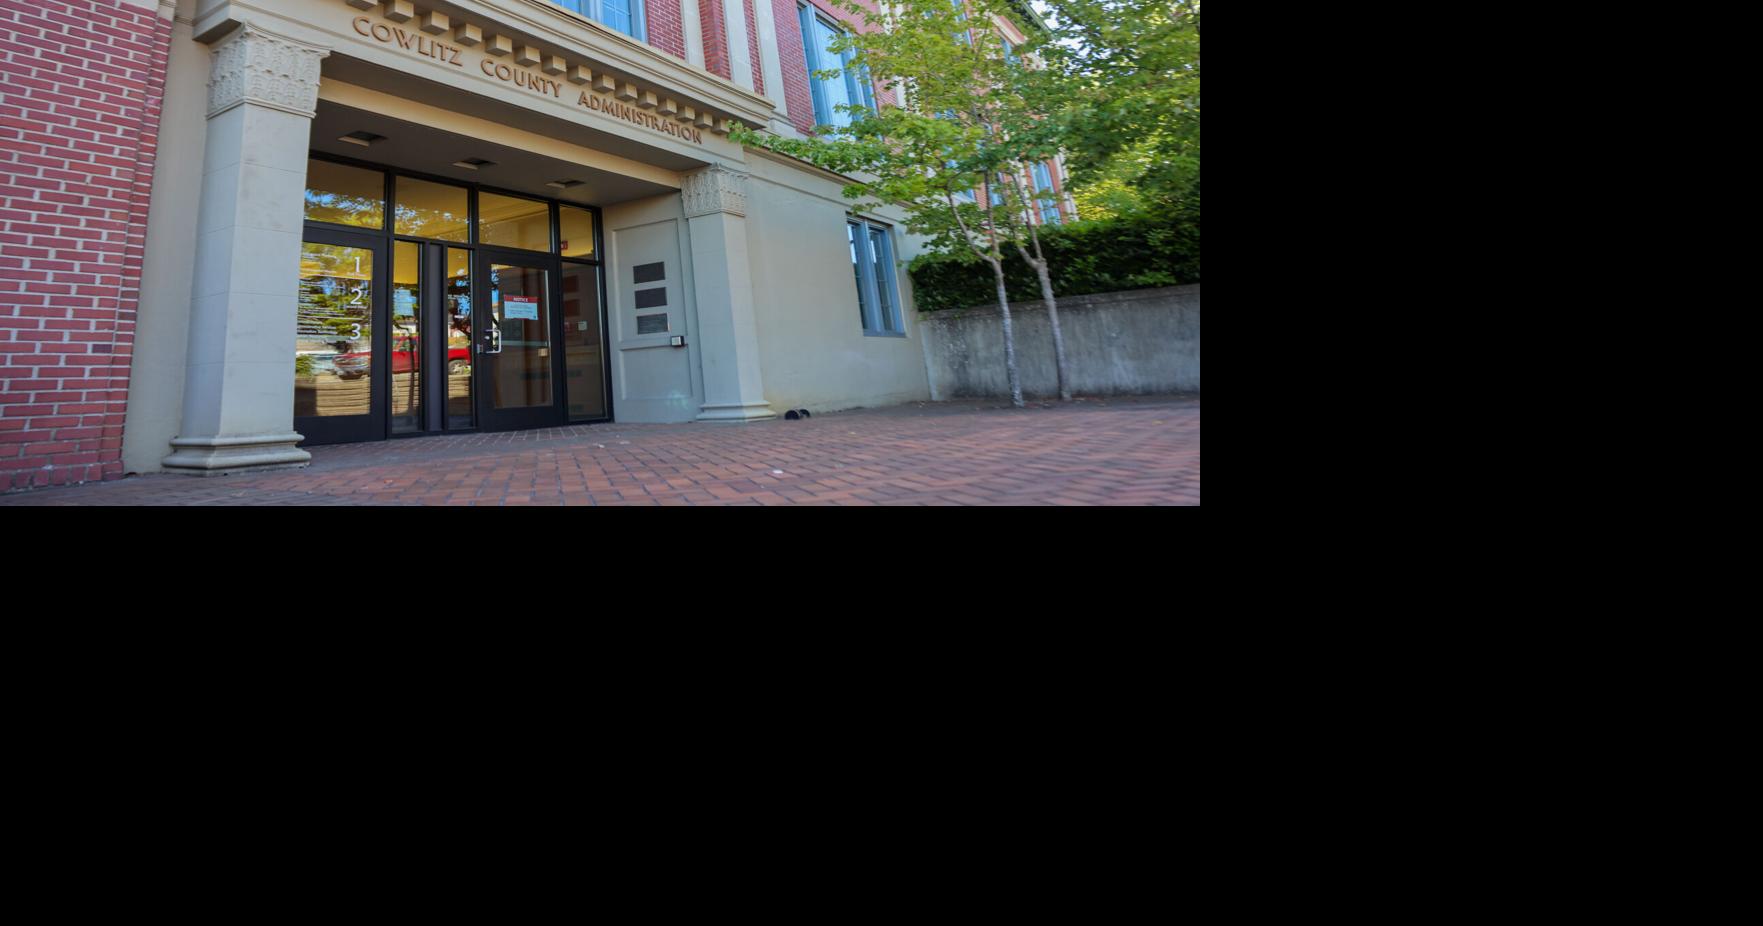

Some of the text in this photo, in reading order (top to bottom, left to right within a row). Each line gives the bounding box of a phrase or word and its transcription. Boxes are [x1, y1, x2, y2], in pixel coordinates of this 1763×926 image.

[352, 15, 703, 145] COWLITZ COUNTY ADMINISTRATION
[354, 256, 361, 273] 1
[350, 288, 362, 305] 2
[349, 323, 361, 340] 3
